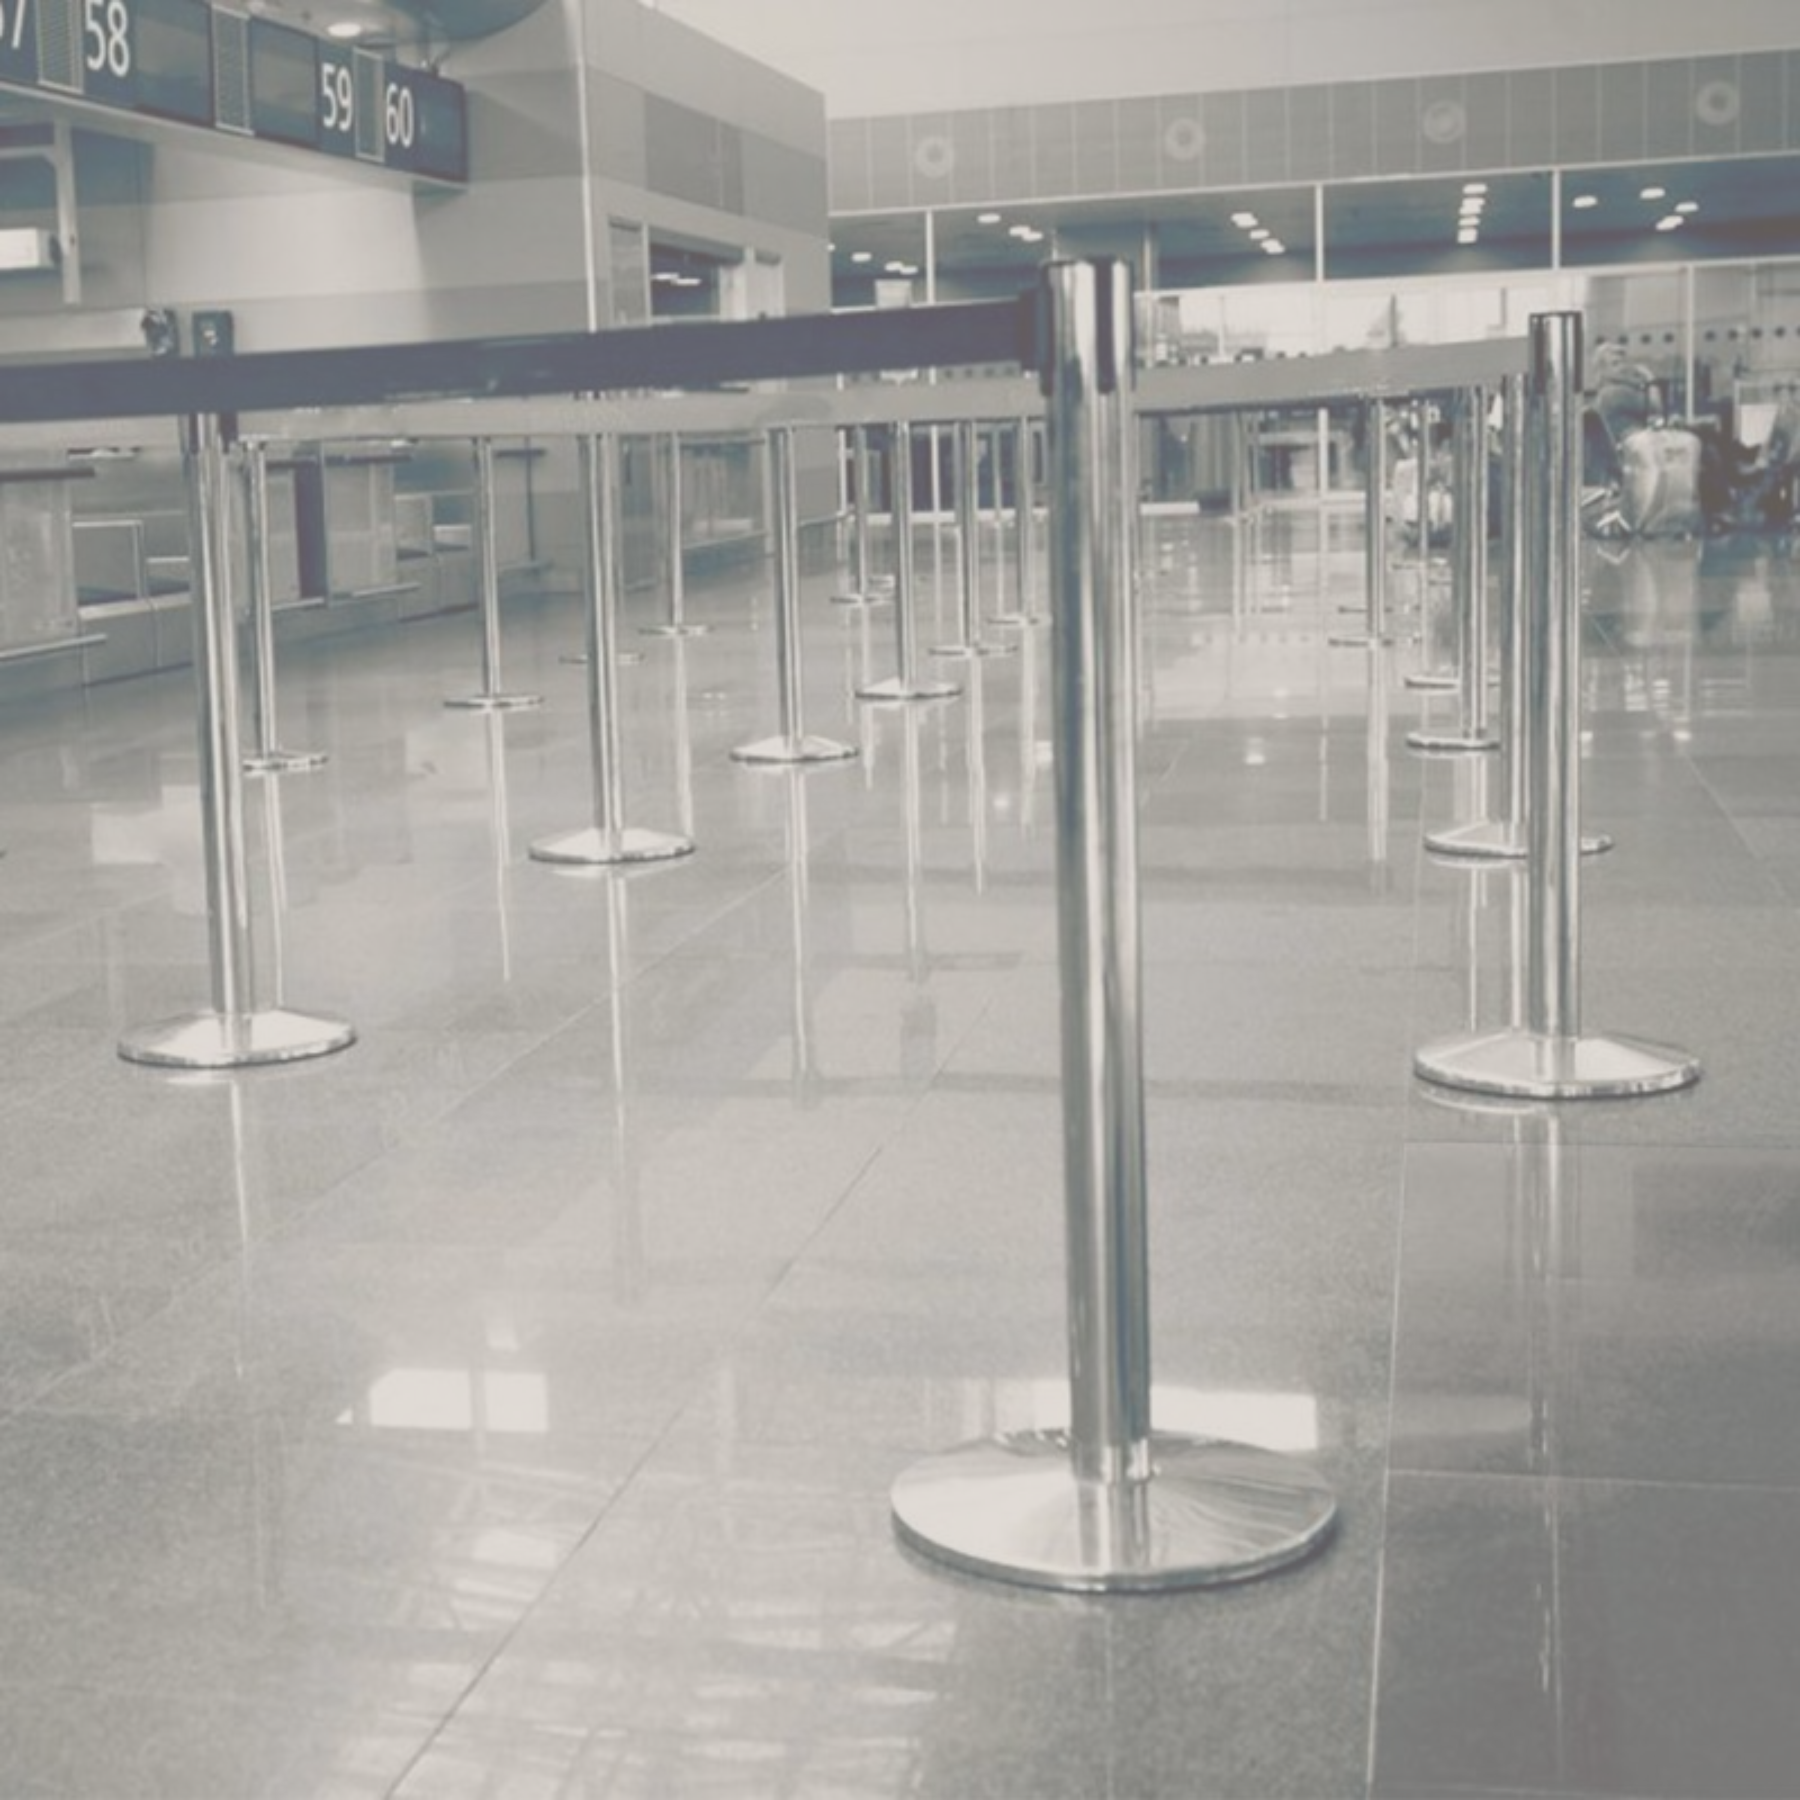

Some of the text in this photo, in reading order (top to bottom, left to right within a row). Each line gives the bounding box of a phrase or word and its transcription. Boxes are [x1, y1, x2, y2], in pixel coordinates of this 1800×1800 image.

[85, 0, 130, 76] 58
[322, 63, 352, 131] 59
[386, 82, 414, 148] 60
